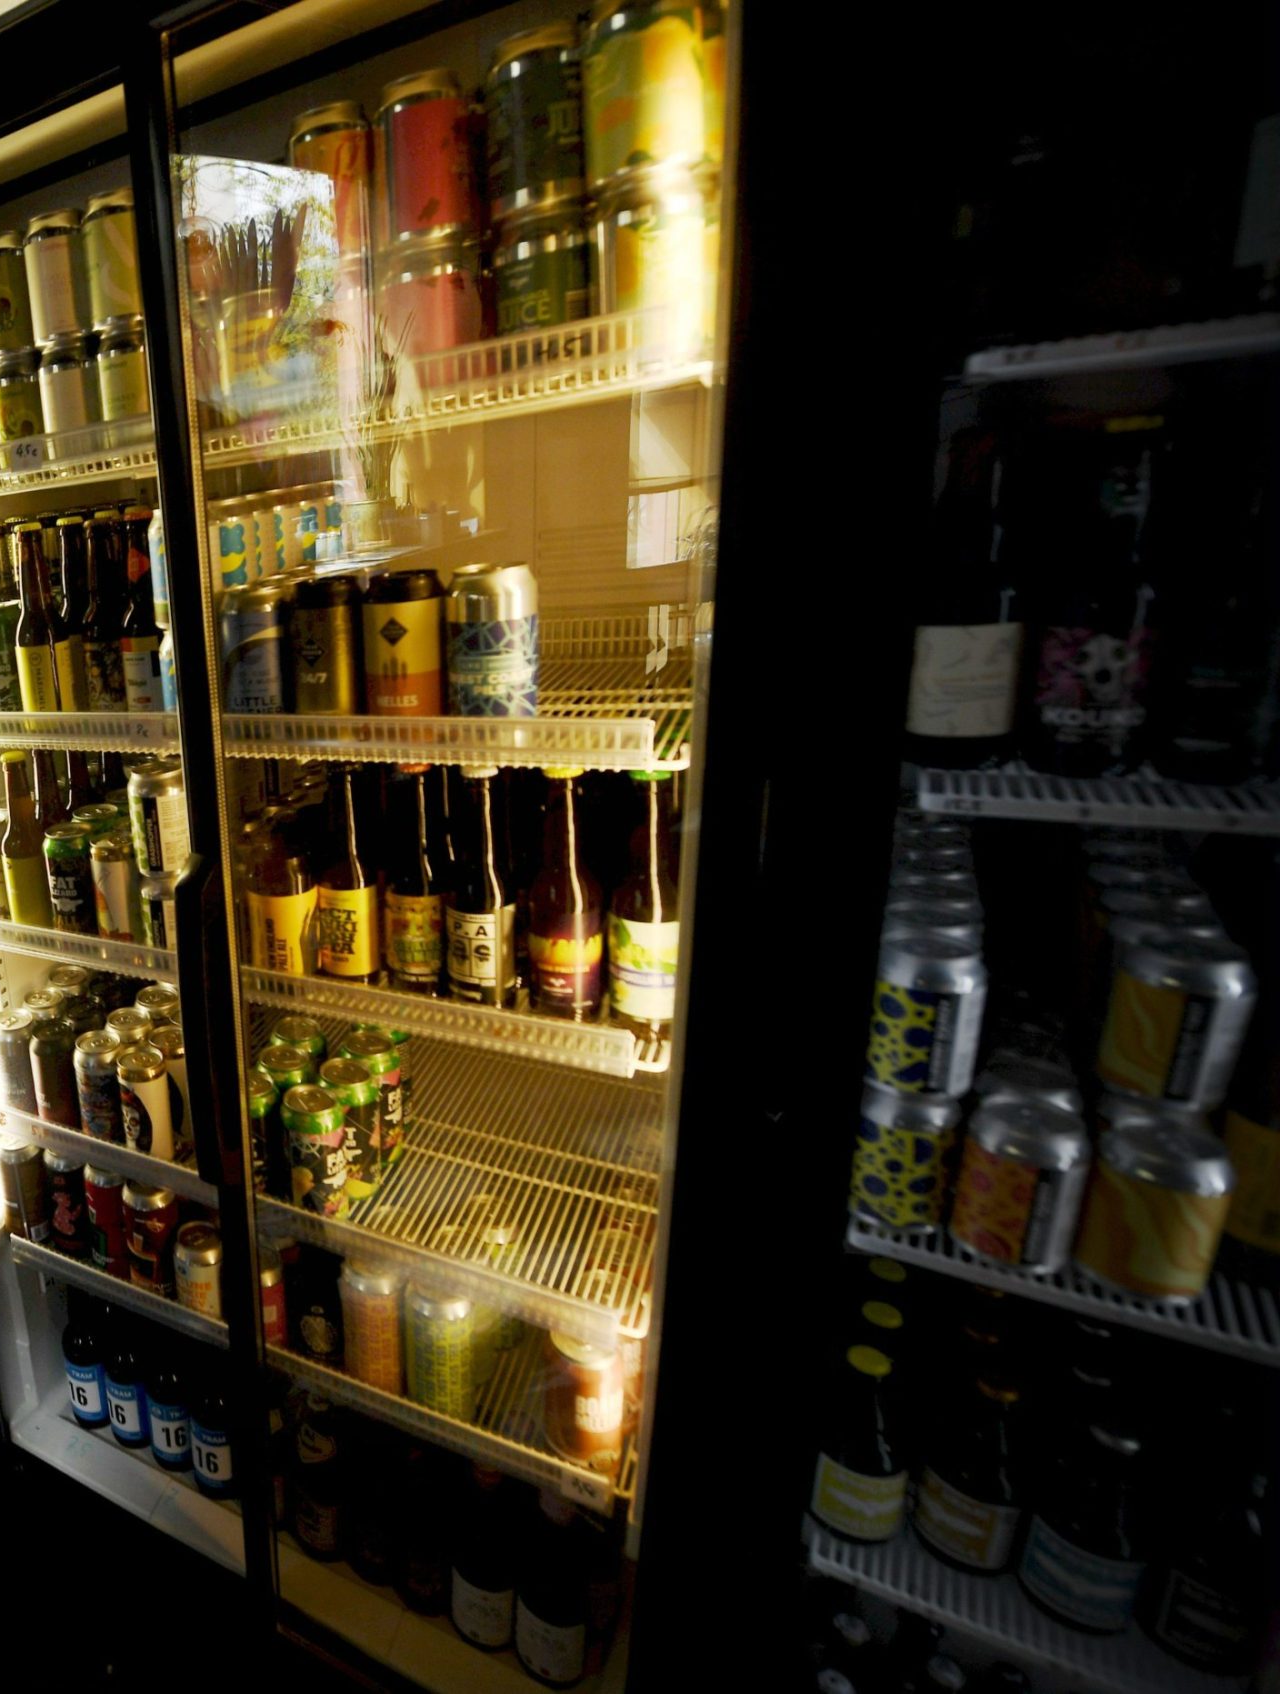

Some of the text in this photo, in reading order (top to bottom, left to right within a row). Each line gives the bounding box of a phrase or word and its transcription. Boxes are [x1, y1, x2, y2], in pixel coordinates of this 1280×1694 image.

[49, 874, 76, 890] FAT
[68, 1380, 88, 1407] 16
[107, 1398, 127, 1426] 16
[161, 1425, 187, 1449] 16
[195, 1445, 220, 1475] 16
